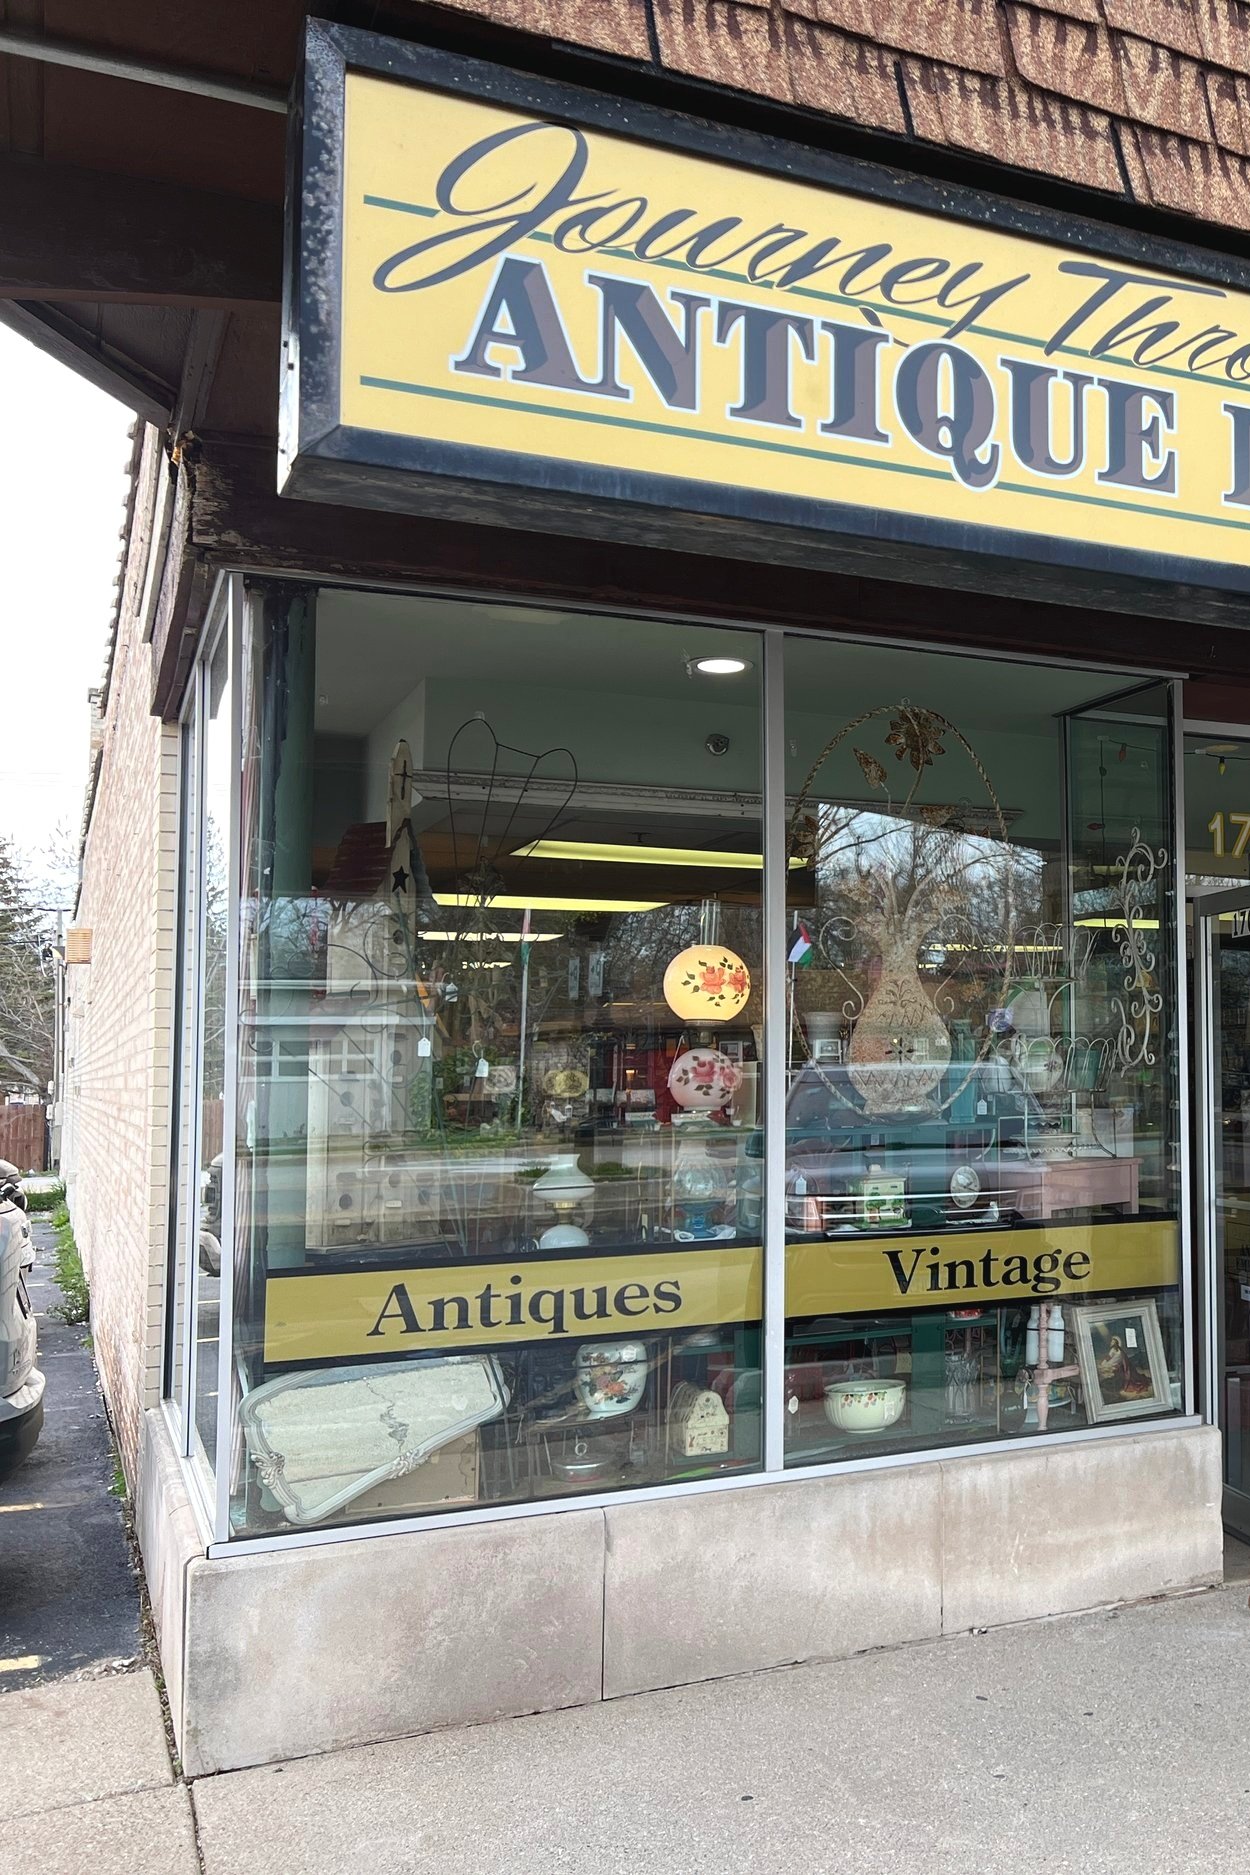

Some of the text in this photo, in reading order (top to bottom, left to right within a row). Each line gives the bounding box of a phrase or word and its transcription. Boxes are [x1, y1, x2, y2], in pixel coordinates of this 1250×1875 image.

[373, 120, 1031, 347] Journey
[450, 253, 1181, 495] ANTIQUE
[366, 1275, 683, 1336] Antiques
[882, 1246, 1091, 1294] Vintage
